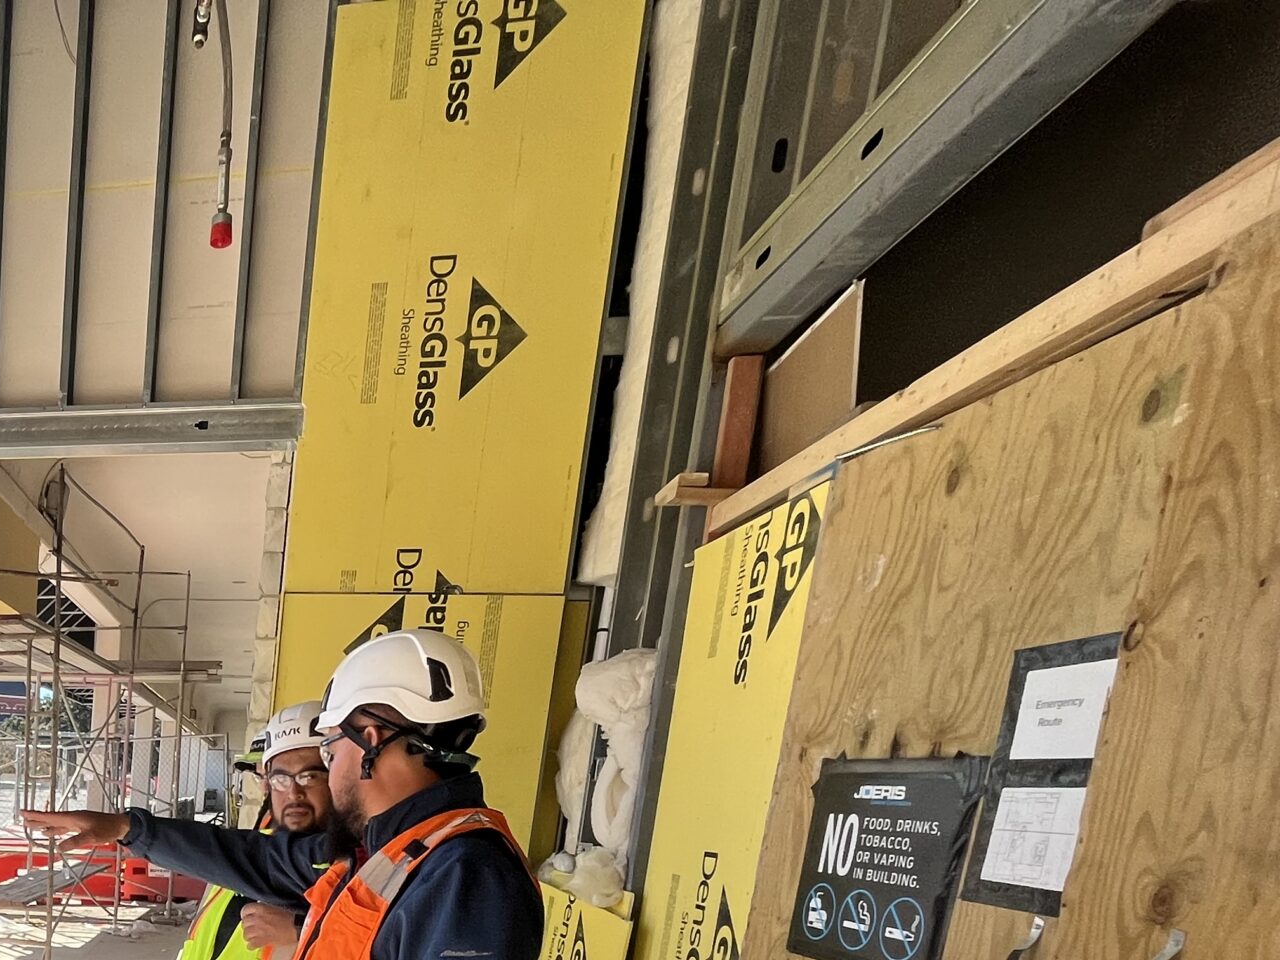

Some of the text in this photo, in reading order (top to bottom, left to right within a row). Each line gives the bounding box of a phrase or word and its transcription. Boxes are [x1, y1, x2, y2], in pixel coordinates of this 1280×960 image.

[393, 308, 415, 376] Sheathing
[412, 254, 458, 429] DensGlass
[469, 304, 502, 368] GP
[781, 498, 810, 591] GP
[730, 524, 754, 617] Sheathing
[1035, 698, 1085, 710] Emergency
[1037, 717, 1063, 727] Route
[274, 727, 302, 740] KASK
[853, 785, 907, 800] JOERIS
[817, 813, 942, 877] NO FOOD, DRINKS,
[859, 834, 913, 852] TOBACCO,
[855, 851, 915, 869] OR VAPING
[852, 867, 920, 889] IN BUILDING.
